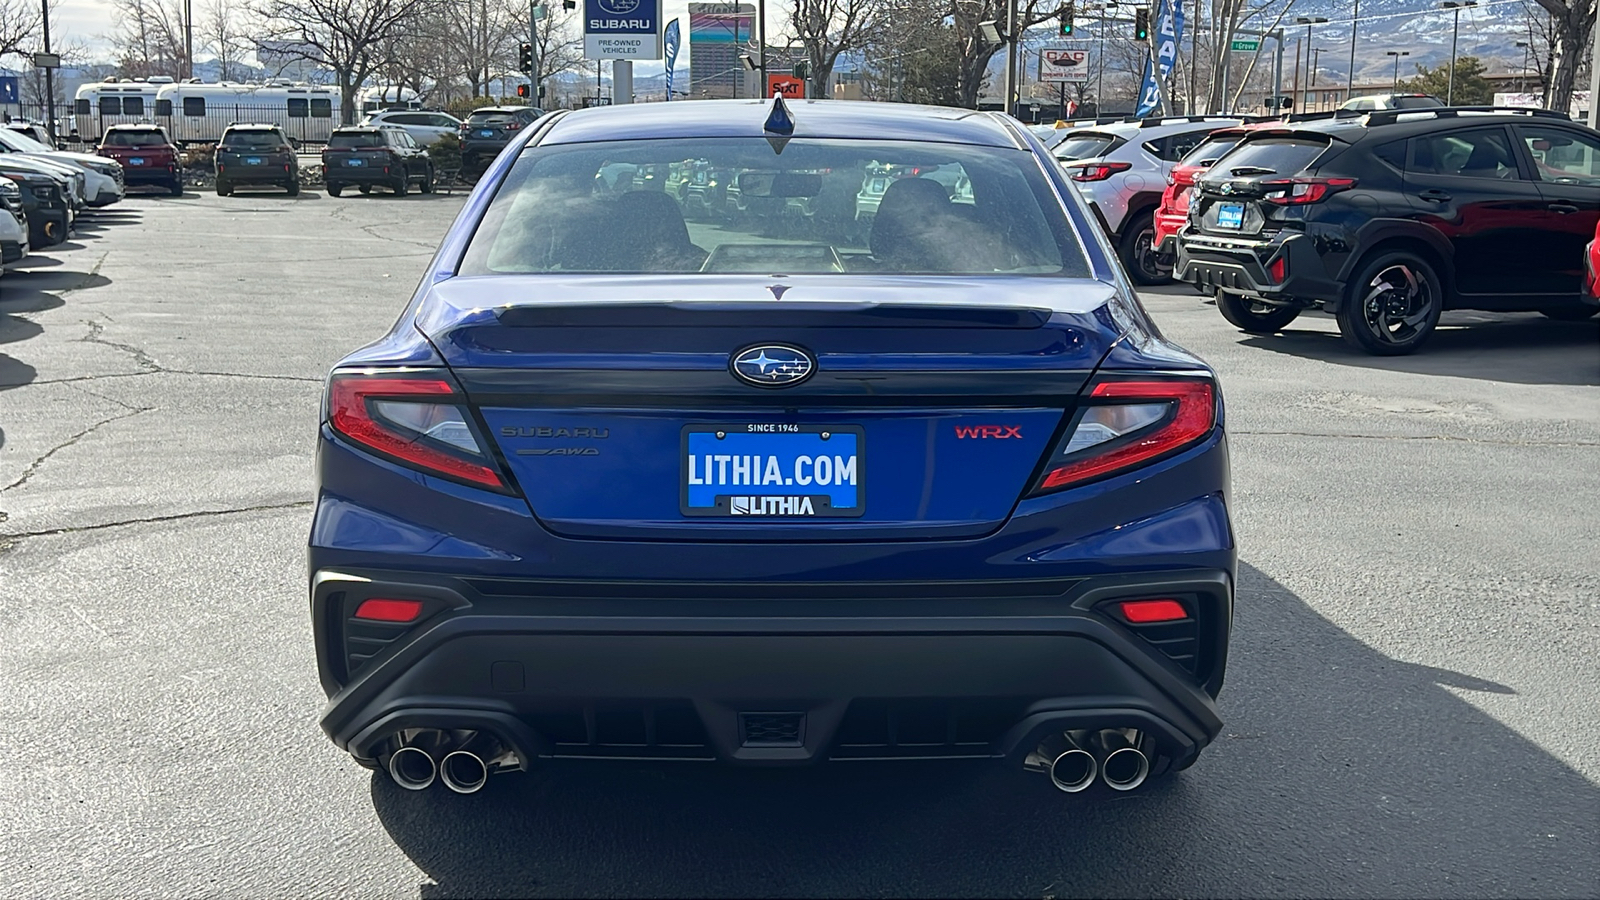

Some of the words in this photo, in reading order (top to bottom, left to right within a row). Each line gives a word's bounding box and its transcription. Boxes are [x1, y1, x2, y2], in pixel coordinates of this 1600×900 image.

[590, 19, 650, 29] SUBARU
[501, 427, 609, 438] SUBARU
[747, 424, 775, 432] SINCE
[778, 424, 799, 432] 1946
[954, 425, 1023, 439] WRX
[547, 447, 600, 456] AWD
[688, 454, 857, 486] LITHIA.COM
[750, 496, 815, 515] LITHIA
